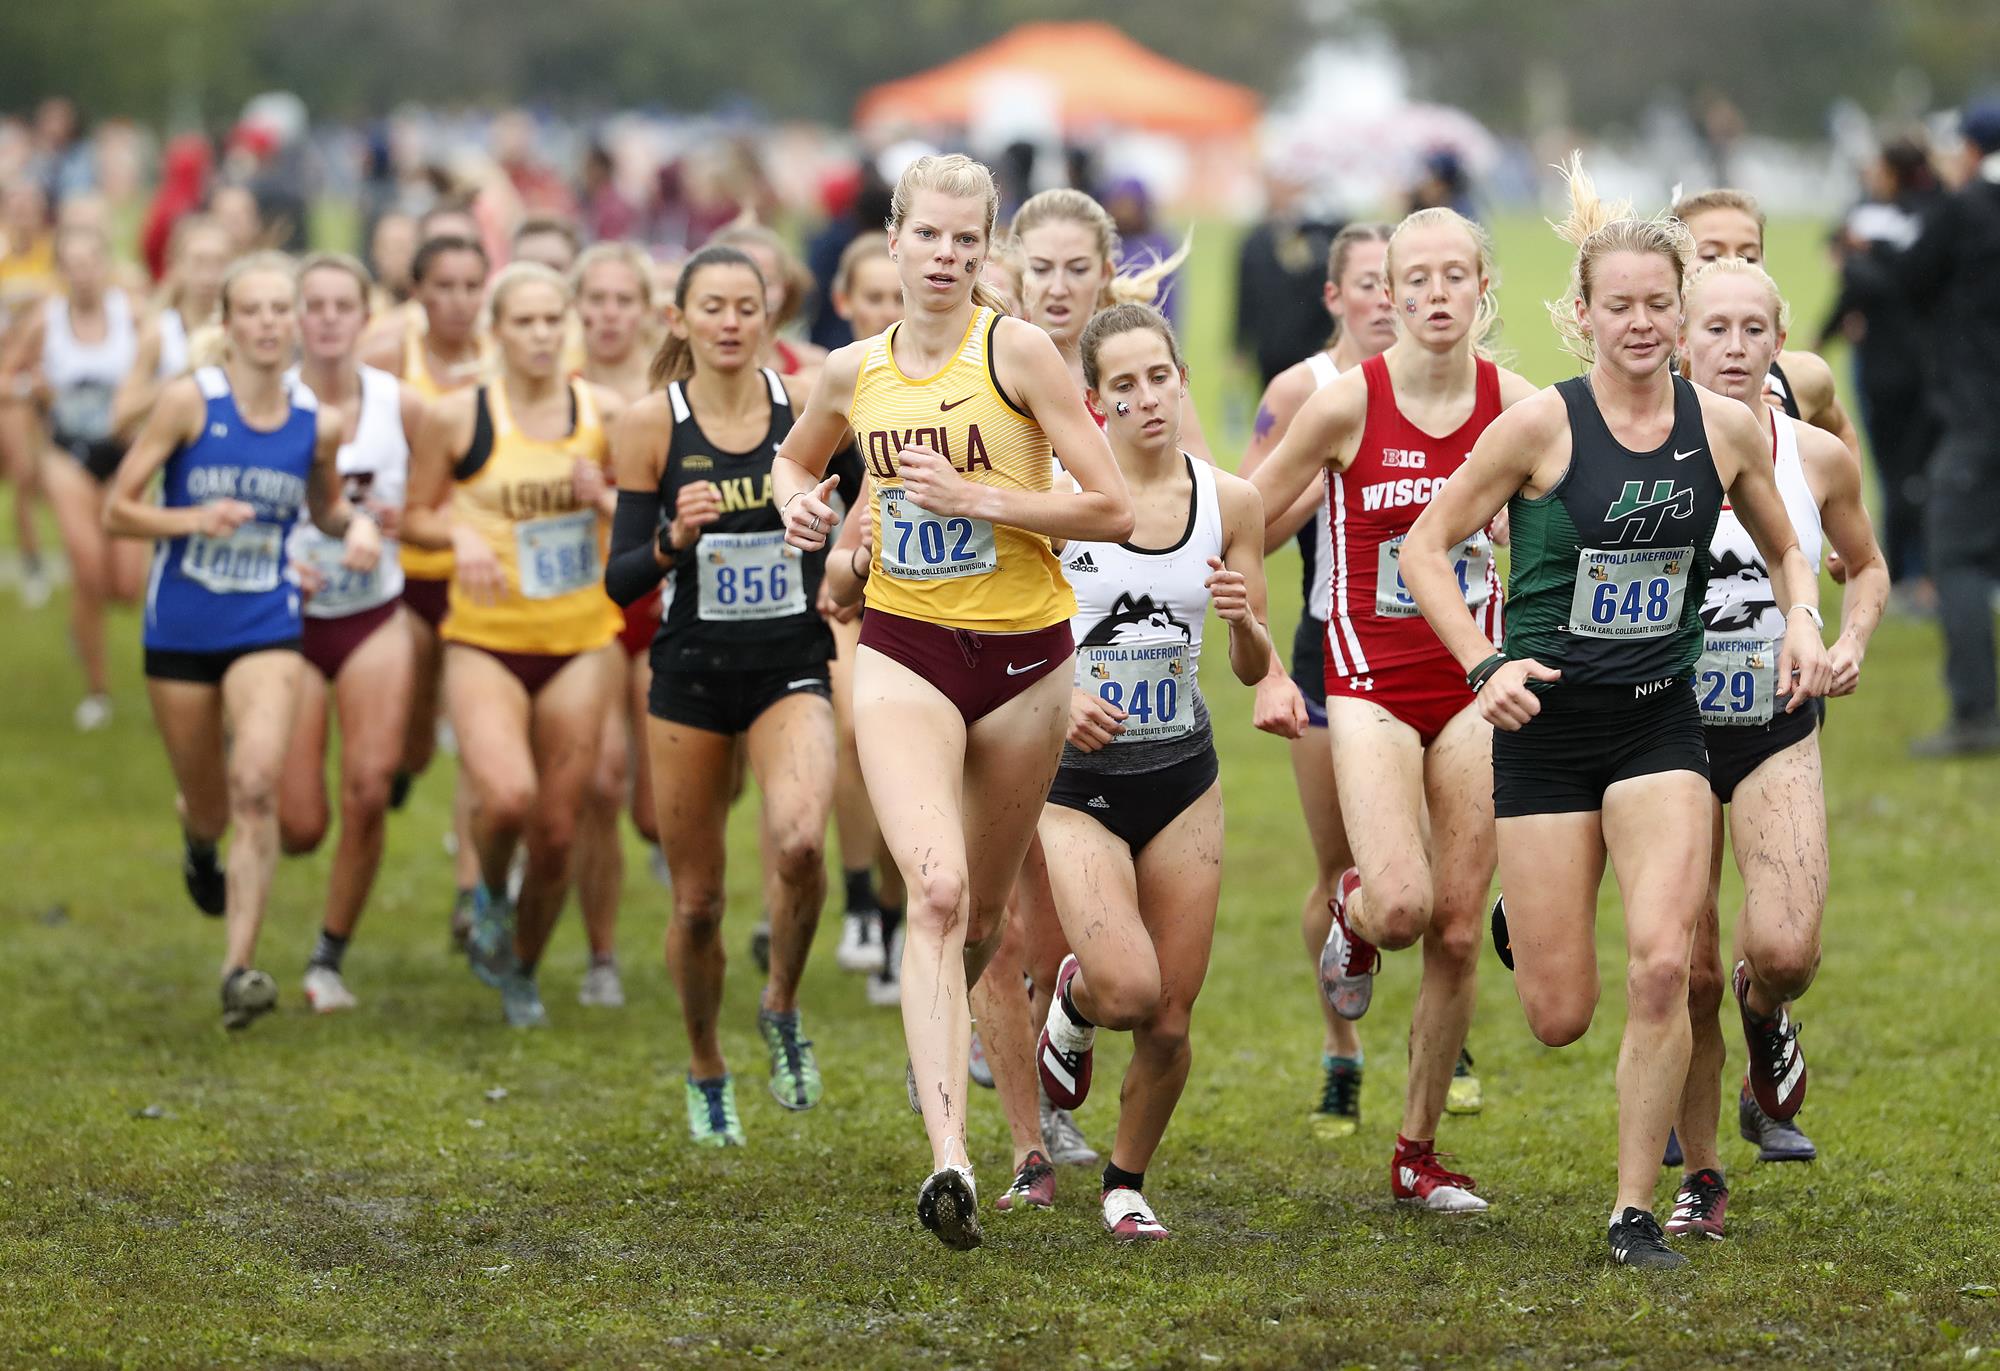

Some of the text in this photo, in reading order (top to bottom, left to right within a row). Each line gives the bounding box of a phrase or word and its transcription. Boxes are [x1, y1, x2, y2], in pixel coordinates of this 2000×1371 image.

[187, 466, 240, 497] OAK
[894, 518, 976, 564] 702
[1590, 550, 1685, 564] LOYOLA LAKEFRONT
[891, 562, 986, 576] SEAN EARL COLLEGIATE DIVISION
[1069, 563, 1099, 573] adidas
[717, 564, 787, 604] 856
[1592, 578, 1670, 624] 648
[1580, 624, 1596, 632] SEAN
[1615, 626, 1649, 634] COLLEGIATE
[1090, 645, 1183, 662] LOYOLA LAKEFRONT
[1706, 640, 1764, 652] LAKEFRONT
[1634, 677, 1673, 699] NIKE
[1692, 671, 1754, 712] 29
[1100, 678, 1177, 724] 840
[1700, 715, 1763, 723] OLLEGIATE DIVISION
[1127, 727, 1160, 737] COLLEGIATE
[1162, 724, 1186, 733] DIVISION
